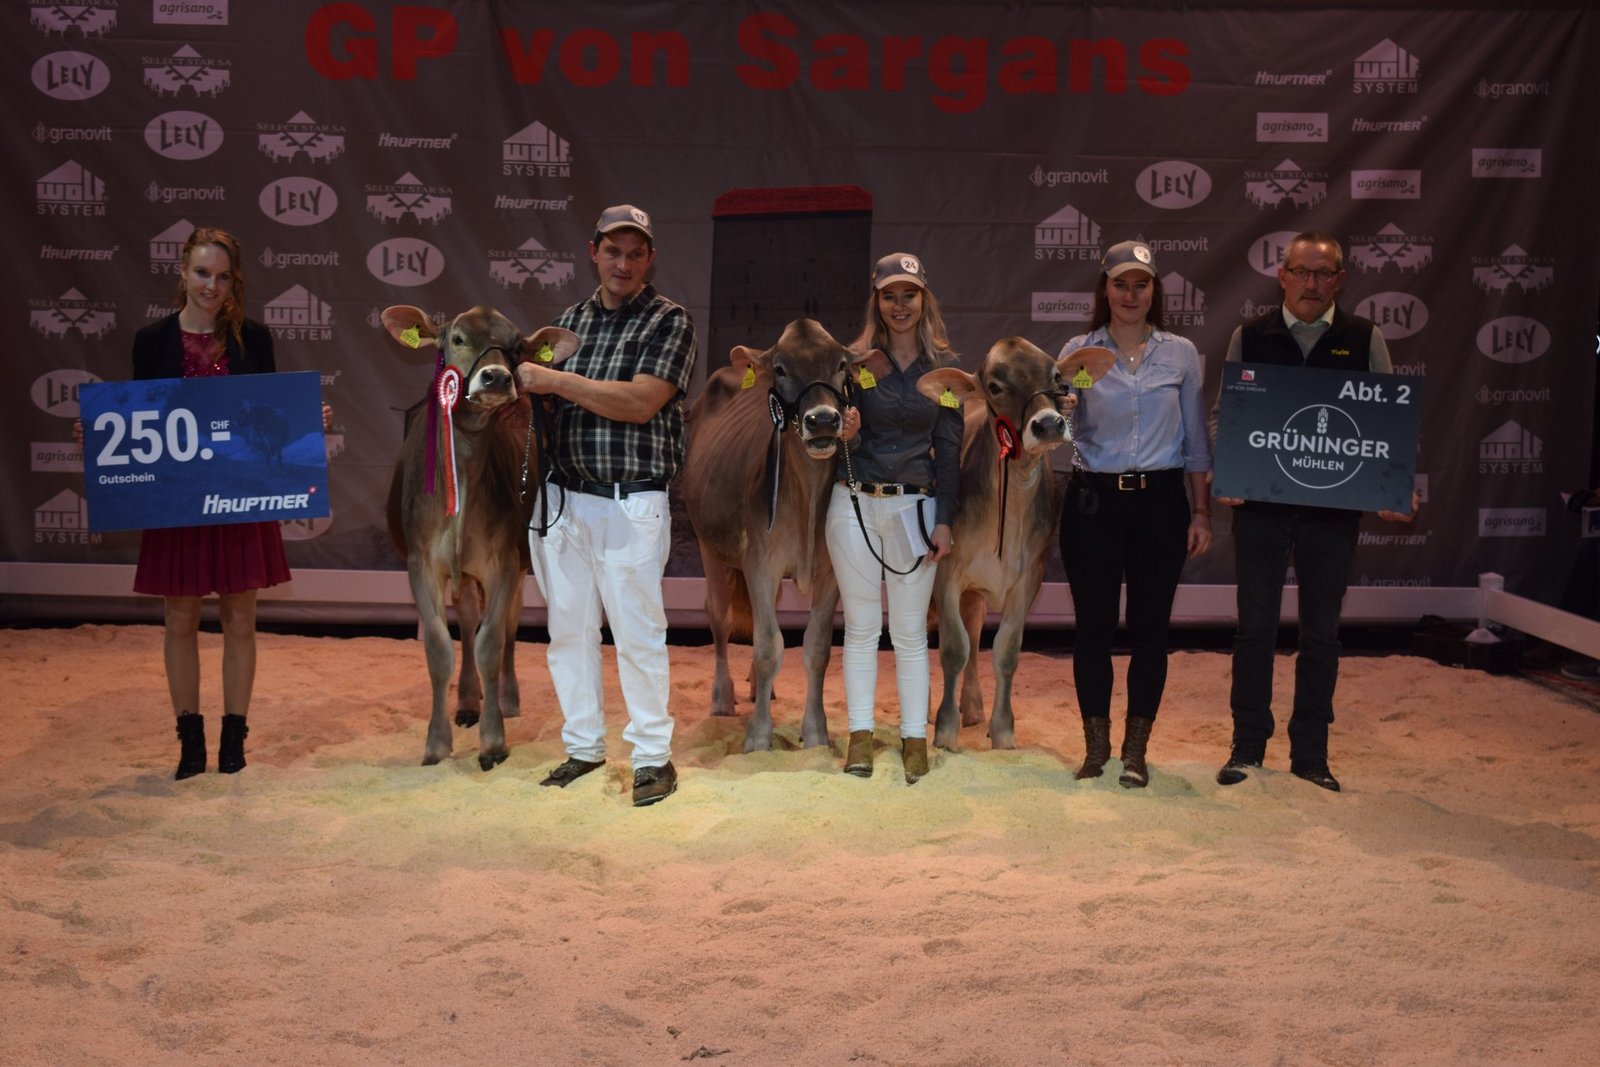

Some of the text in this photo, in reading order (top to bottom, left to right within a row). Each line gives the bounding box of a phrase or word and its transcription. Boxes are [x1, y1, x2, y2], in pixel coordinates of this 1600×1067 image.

[160, 2, 214, 16] agrisano
[142, 56, 232, 66] SELECT STAR SA
[305, 3, 1192, 114] GP von Sargans
[48, 60, 94, 90] LELY
[1255, 70, 1326, 85] HAUPTNER
[1353, 82, 1418, 94] SYSTEM
[1492, 80, 1550, 99] granovit
[257, 122, 346, 132] SELECT STAR SA
[1262, 119, 1314, 132] agrisano
[1352, 118, 1422, 132] HAUPTNER
[50, 126, 112, 143] granovit
[160, 120, 207, 150] LELY
[378, 133, 451, 149] HAUPTNER
[1478, 155, 1528, 168] agrisano
[503, 164, 570, 177] SYSTEM
[1244, 170, 1330, 180] SELECT STAR SA
[1048, 169, 1108, 187] granovit
[1151, 170, 1197, 200] LELY
[1357, 177, 1408, 190] agrisano
[164, 186, 225, 202] granovit
[364, 183, 453, 194] SELECT STAR SA
[275, 185, 322, 216] LELY
[495, 195, 568, 210] HAUPTNER
[37, 204, 106, 216] SYSTEM
[1150, 237, 1208, 254] granovit
[1349, 234, 1434, 244] SELECT STAR SA
[40, 245, 113, 261] HAUPTNER
[278, 251, 340, 268] granovit
[488, 249, 575, 260] SELECT STAR SA
[1034, 249, 1100, 260] SYSTEM
[1264, 240, 1286, 270] LE
[383, 246, 429, 276] LELY
[905, 260, 916, 269] 24
[150, 263, 181, 274] SYS
[1038, 299, 1090, 312] agrisano
[1162, 315, 1204, 326] STEM
[1370, 300, 1414, 330] LELY
[270, 329, 332, 340] YSTEM
[1492, 324, 1536, 354] LELY
[1338, 380, 1410, 404] Abt. 2
[1494, 388, 1551, 405] granovit
[211, 420, 230, 430] CHF
[1248, 429, 1390, 459] GRÜNINGER
[36, 449, 82, 464] agrisan
[1292, 456, 1344, 472] MÜHLEN
[1479, 463, 1543, 474] SYSTEM
[99, 472, 156, 484] Gutschein
[202, 494, 310, 515] HAUPTNER
[1484, 516, 1535, 529] agrisano
[34, 532, 102, 544] SYSTEM
[1358, 532, 1427, 545] HAUPTNER
